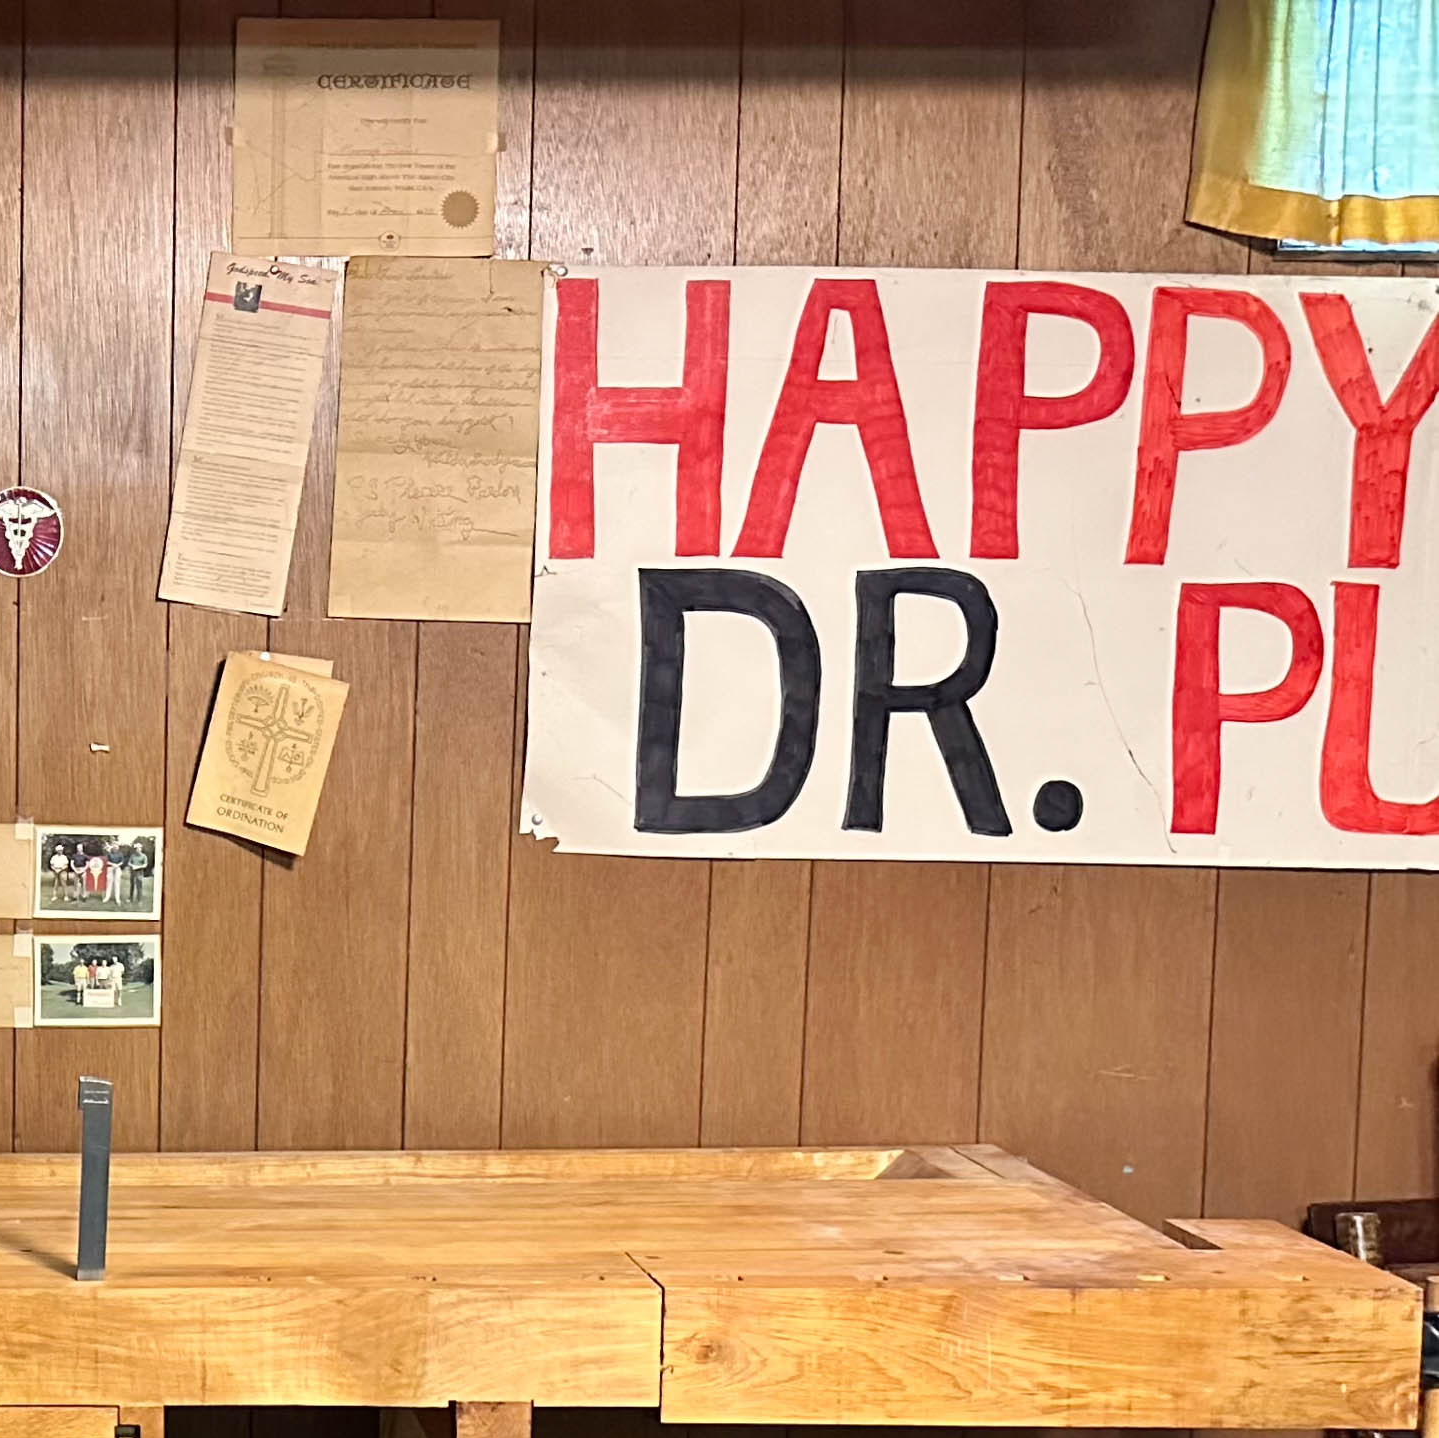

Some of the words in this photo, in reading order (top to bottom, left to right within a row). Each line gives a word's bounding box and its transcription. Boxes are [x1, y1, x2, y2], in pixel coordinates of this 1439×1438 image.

[317, 73, 474, 90] CERTIFICATE
[548, 277, 1439, 569] HAPPY
[633, 566, 1084, 837] DR.
[215, 805, 284, 834] ORDINATION
[219, 793, 275, 817] CERTIFICATE
[275, 810, 290, 821] OF
